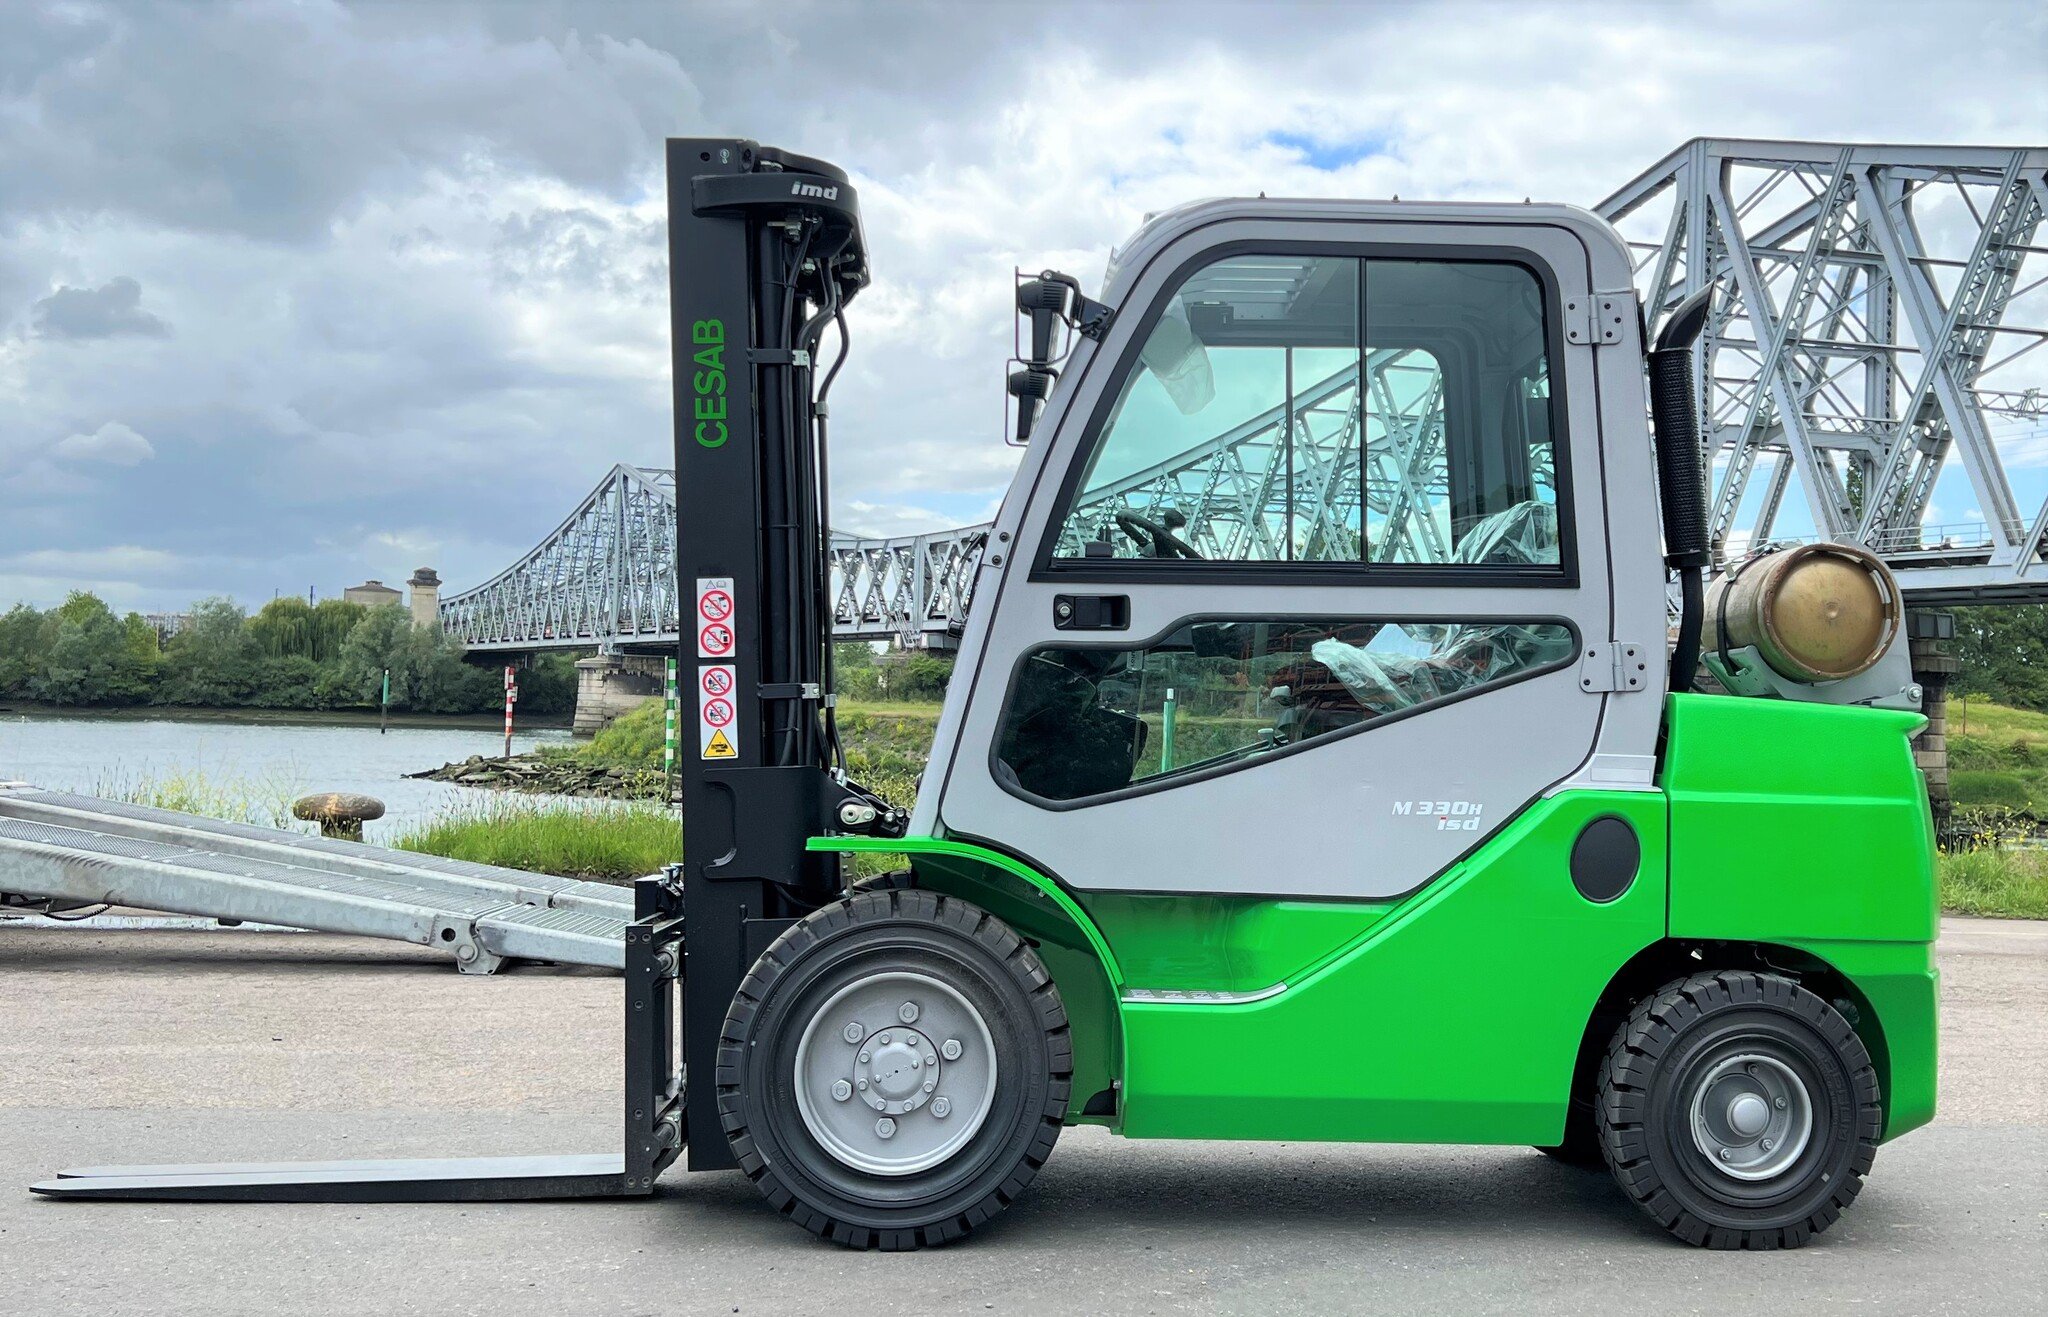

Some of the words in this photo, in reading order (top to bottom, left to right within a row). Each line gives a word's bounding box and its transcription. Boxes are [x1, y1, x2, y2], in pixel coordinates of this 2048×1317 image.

[791, 181, 839, 201] imd
[692, 318, 728, 449] CESAB
[1391, 801, 1413, 815] M
[1416, 801, 1483, 815] 330H
[1437, 816, 1481, 831] isd
